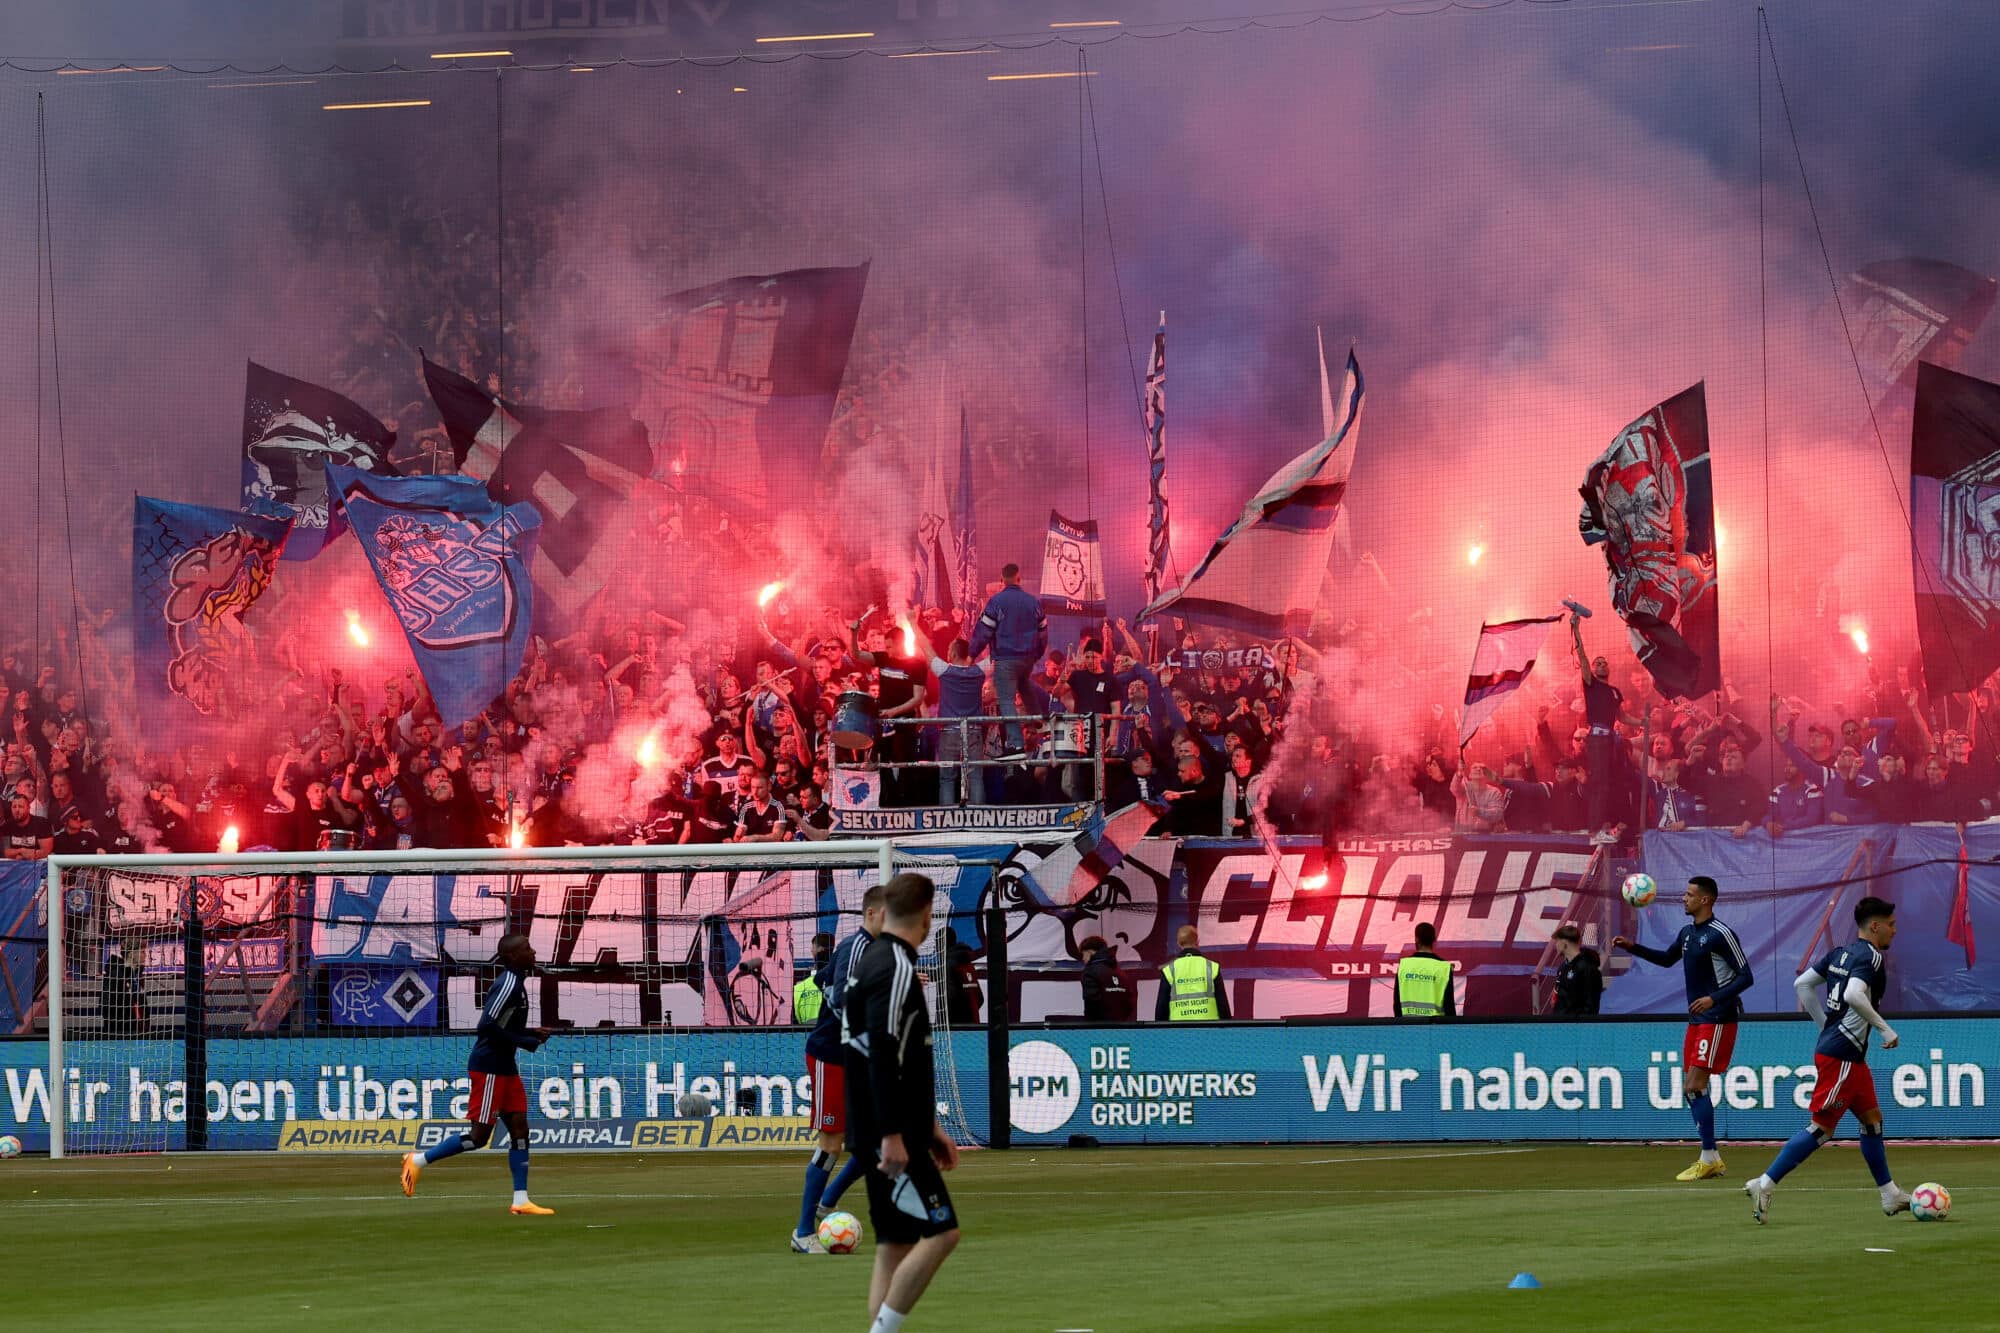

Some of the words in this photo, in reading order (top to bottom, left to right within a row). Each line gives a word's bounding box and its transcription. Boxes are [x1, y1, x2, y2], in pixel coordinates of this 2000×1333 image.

[841, 811, 916, 830] SEKTION
[922, 807, 1060, 828] STADIONVERBOT
[1338, 837, 1453, 853] ULTRAS
[1091, 1046, 1131, 1070] DIE
[1698, 1039, 1709, 1055] 9
[5, 1067, 110, 1123] Wir
[317, 1064, 472, 1121] übera
[538, 1062, 623, 1119] ein
[645, 1061, 814, 1118] Heims
[1010, 1075, 1069, 1098] HPM
[1091, 1073, 1257, 1098] HANDWERKS
[1302, 1053, 1420, 1112] Wir
[1439, 1051, 1624, 1111] haben
[1647, 1051, 1818, 1110] üera
[1892, 1048, 1985, 1108] ein
[1092, 1101, 1193, 1126] GRUPPE
[285, 1126, 416, 1148] ADMIRAL
[637, 1124, 699, 1145] BET
[716, 1124, 820, 1145] ADMIR
